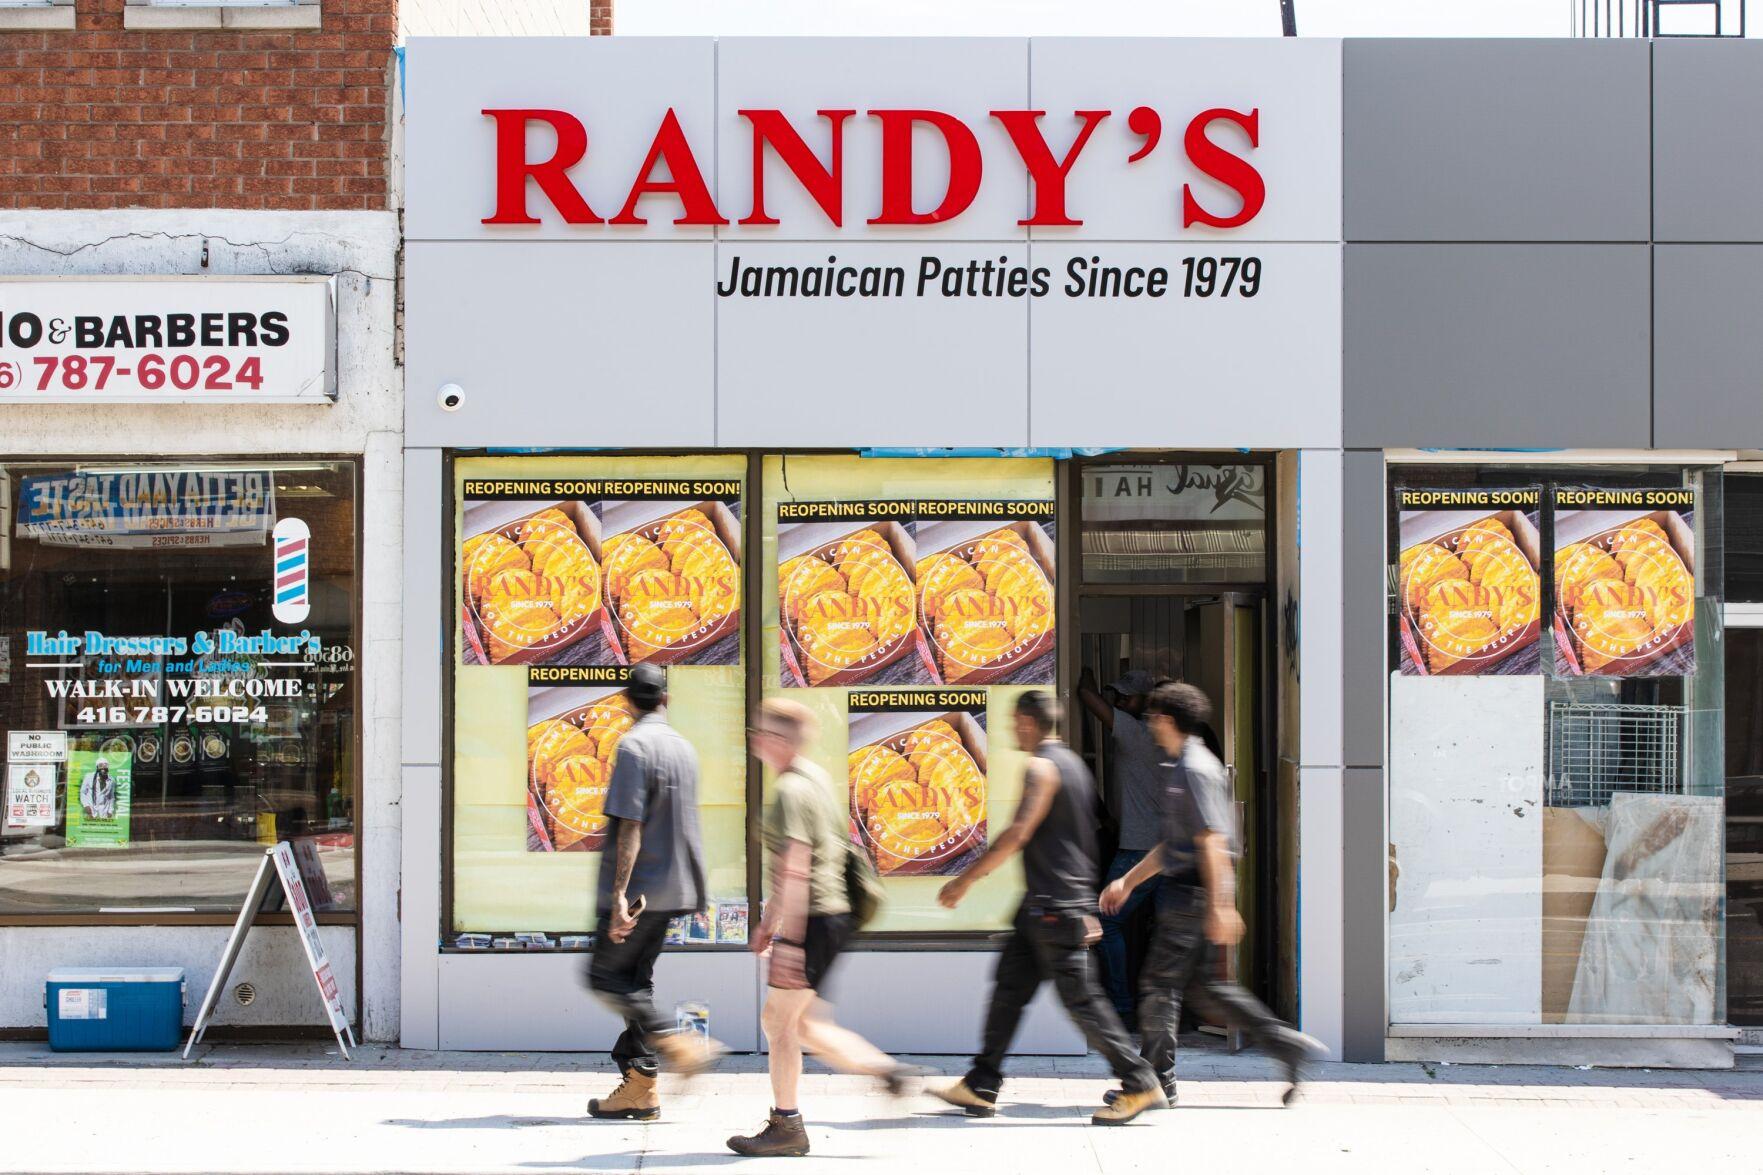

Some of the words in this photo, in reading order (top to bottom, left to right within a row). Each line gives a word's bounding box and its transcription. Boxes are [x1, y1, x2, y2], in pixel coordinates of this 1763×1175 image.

[717, 256, 904, 298] Jamaican
[917, 256, 1051, 298] Patties
[1065, 256, 1167, 298] Since
[1182, 257, 1262, 298] 1979
[0, 311, 42, 348] O
[48, 318, 72, 344] &
[75, 311, 290, 349] BARBERS
[33, 354, 264, 391] 787-6024
[466, 483, 550, 494] REOPENING
[554, 483, 601, 494] SOON!
[605, 483, 689, 494] REOPENING
[694, 483, 740, 494] SOON!
[1402, 493, 1487, 504] REOPENING
[1492, 492, 1539, 504] SOON!
[1557, 493, 1642, 504] REOPENING
[1646, 492, 1693, 504] SOON!
[780, 504, 865, 516] REOPENING
[868, 503, 915, 515] SOON!
[919, 503, 1003, 514] REOPENING
[1007, 503, 1053, 514] SOON!
[535, 600, 554, 608] 1979
[673, 600, 692, 608] 1979
[1472, 610, 1491, 618] 1979
[1626, 610, 1645, 618] 1979
[987, 620, 1006, 628] 1979
[26, 630, 82, 656] Hair
[85, 631, 187, 656] Dressers
[192, 631, 215, 655] &
[508, 630, 533, 643] THE
[646, 630, 671, 643] THE
[1445, 640, 1470, 653] THE
[1599, 640, 1624, 653] THE
[825, 652, 850, 666] THE
[960, 650, 985, 663] THE
[98, 659, 122, 674] for
[126, 659, 160, 673] Men
[165, 659, 193, 673] and
[200, 659, 250, 673] Ladies
[531, 669, 615, 680] REOPENING
[44, 680, 159, 699] WALK-IN
[167, 679, 302, 698] WELCOME
[850, 694, 935, 705] REOPENING
[939, 693, 985, 705] SOON!
[77, 707, 126, 723] 416
[134, 706, 268, 723] 787-6024
[15, 795, 49, 803] WATCH
[115, 769, 131, 820] FESTIVAL
[921, 812, 940, 820] 1979
[894, 842, 919, 855] THE
